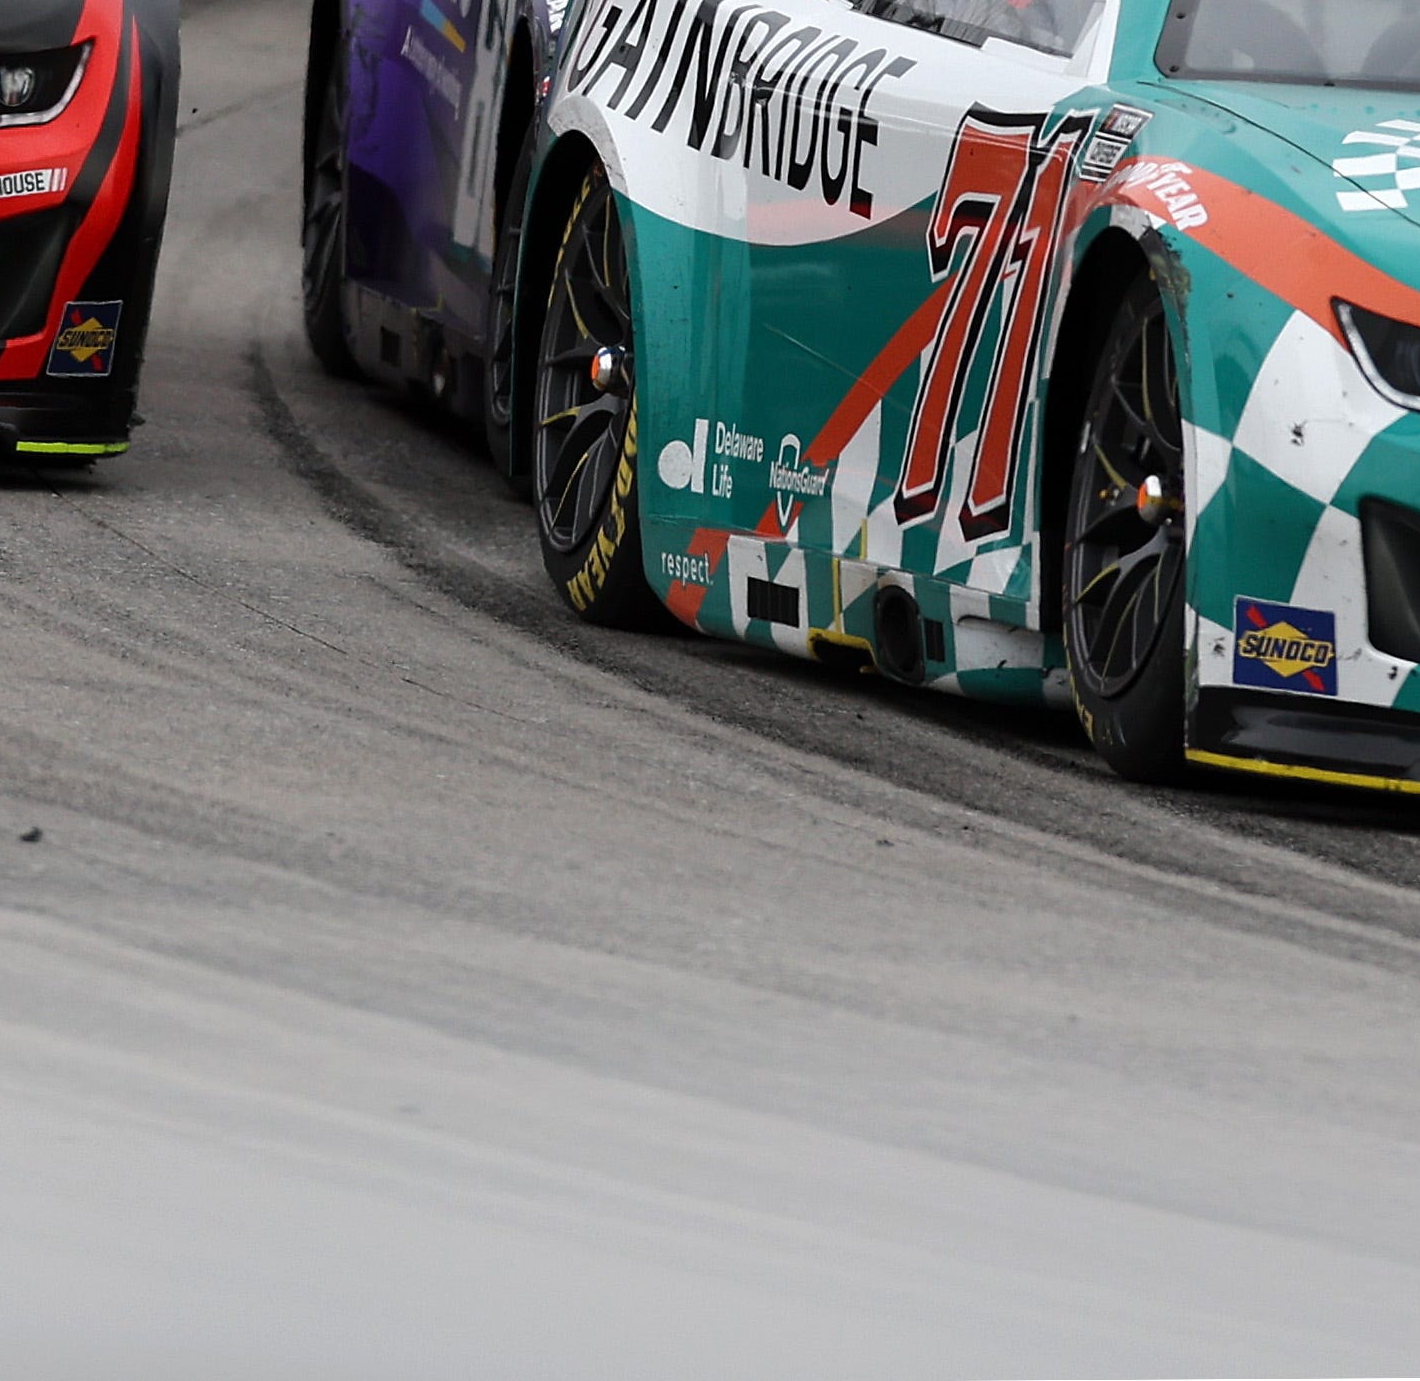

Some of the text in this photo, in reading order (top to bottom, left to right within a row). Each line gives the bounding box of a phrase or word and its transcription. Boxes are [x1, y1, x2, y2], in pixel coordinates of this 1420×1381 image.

[59, 326, 114, 351] SUNOCO
[893, 100, 1101, 543] 71
[715, 421, 765, 463] Delaware
[712, 464, 733, 500] Life
[769, 460, 829, 497] NationsGuard
[661, 551, 714, 587] respect.
[1241, 633, 1332, 665] SUNOCO
